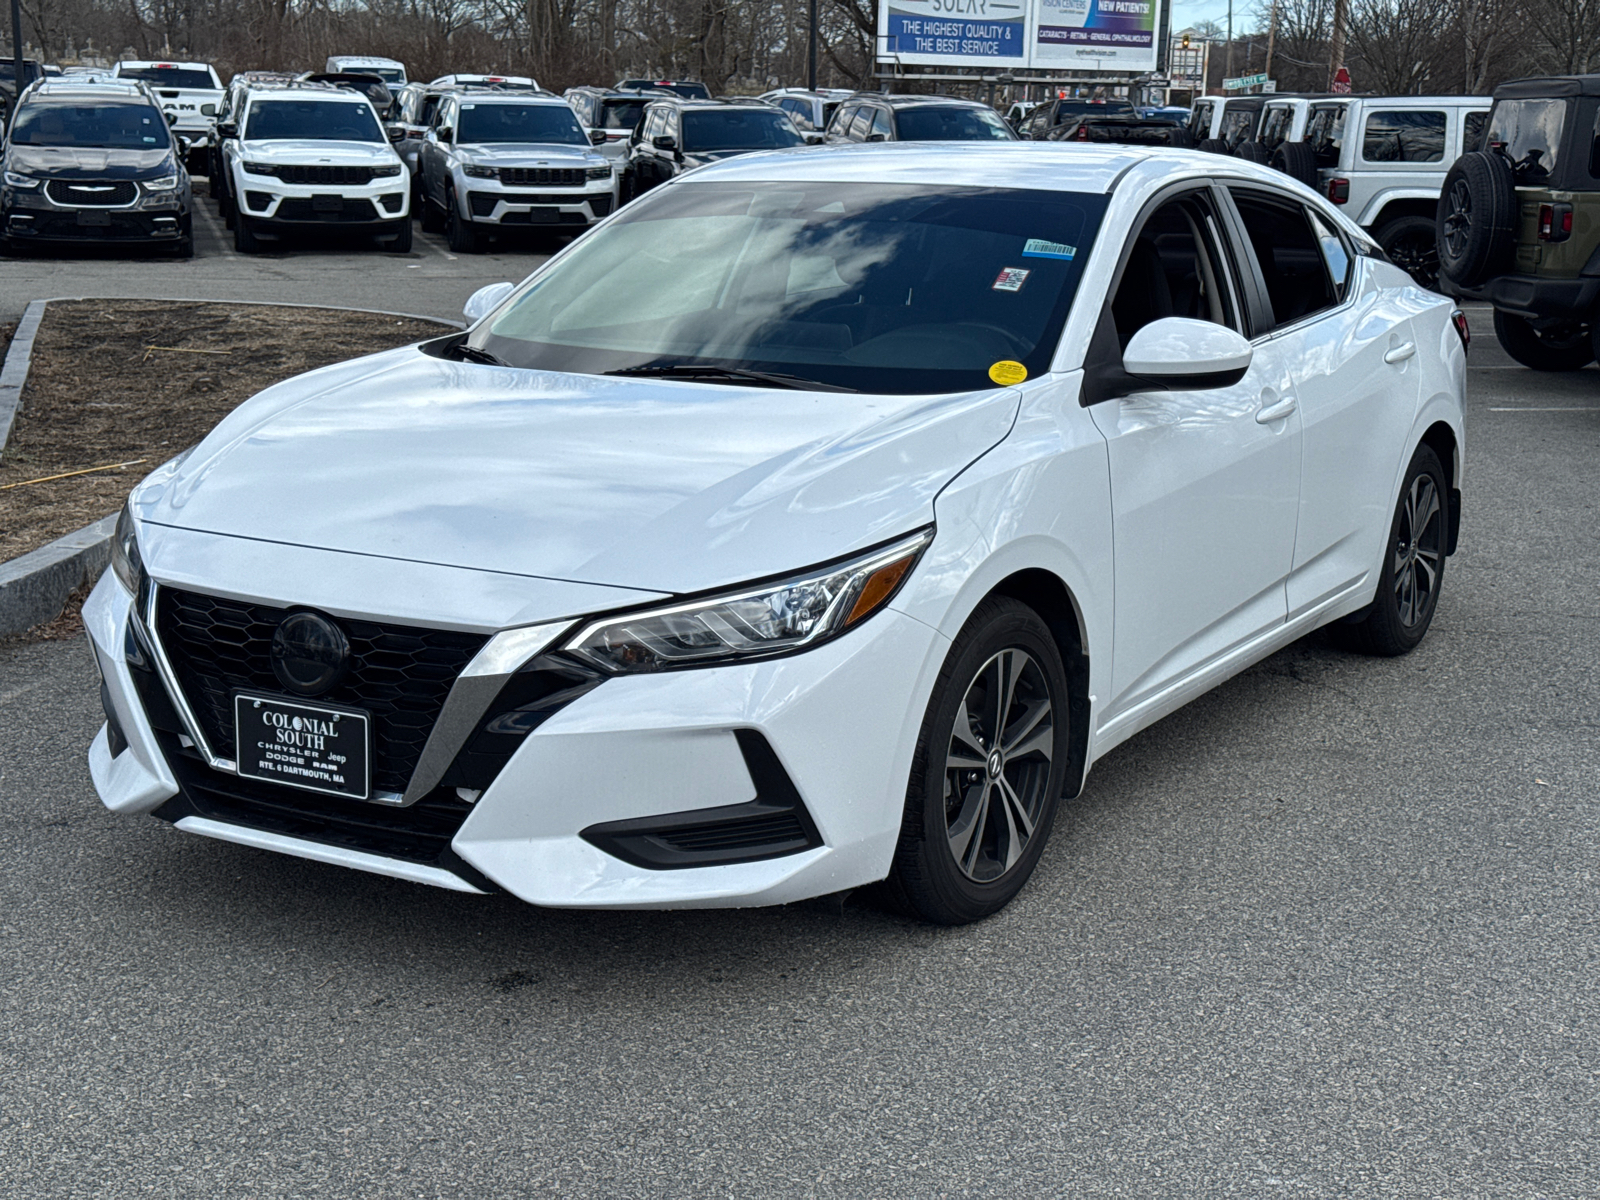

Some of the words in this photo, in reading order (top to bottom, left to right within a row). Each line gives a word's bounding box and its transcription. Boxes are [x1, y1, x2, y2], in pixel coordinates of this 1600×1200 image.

[932, 0, 986, 15] SOLAR
[1098, 0, 1115, 11] NEW
[902, 20, 922, 35] THE
[923, 22, 964, 37] HIGHEST
[965, 24, 1003, 39] QUALITY
[1004, 26, 1011, 40] &
[1039, 30, 1067, 39] CATARACTS
[1070, 31, 1088, 40] RETINA
[1090, 32, 1111, 41] GENERAL
[915, 37, 934, 52] THE
[936, 38, 960, 53] BEST
[961, 40, 999, 55] SERVICE
[162, 103, 196, 111] AM
[262, 711, 339, 737] COLONIAL
[276, 728, 325, 750] SOUTH
[257, 741, 320, 758] CHRYSLER
[327, 752, 347, 764] Jeep
[265, 752, 305, 765] DODGE
[312, 761, 338, 771] RAM
[258, 760, 276, 771] RTE.
[276, 764, 282, 772] 6
[283, 765, 332, 782] DARTMOUTH,
[332, 774, 345, 783] MA
